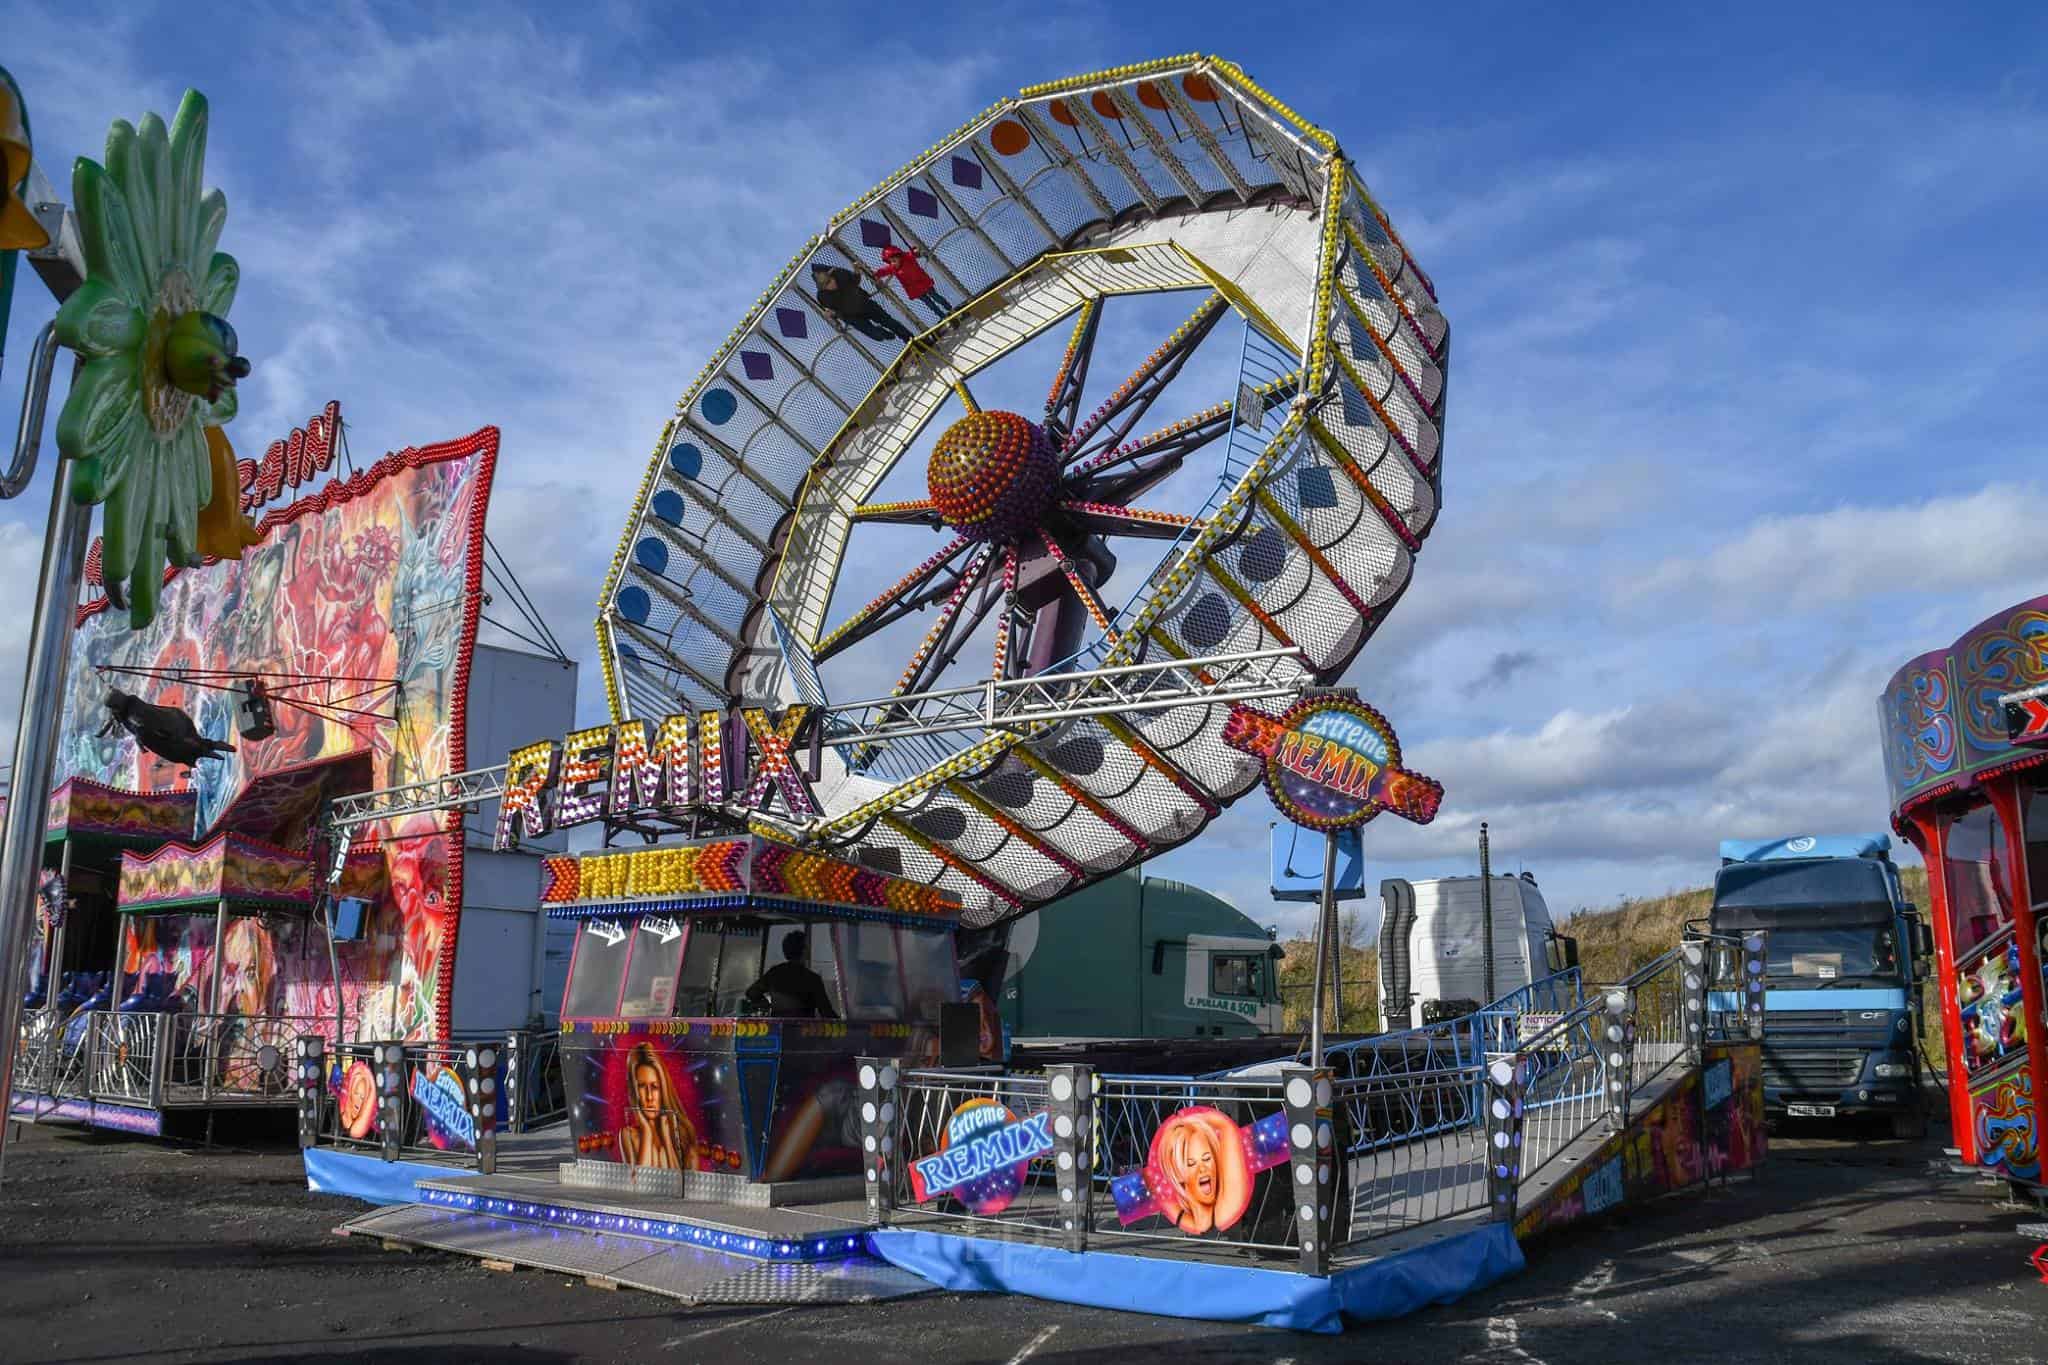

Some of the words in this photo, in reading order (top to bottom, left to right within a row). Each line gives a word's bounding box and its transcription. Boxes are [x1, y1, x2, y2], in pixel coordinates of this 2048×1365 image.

[1302, 713, 1388, 760] Extreme
[493, 704, 825, 851] REMIX
[1276, 730, 1379, 800] REMIX
[579, 852, 630, 901] PAY
[632, 845, 702, 897] HERE
[1238, 1002, 1257, 1018] SON
[1860, 1011, 1888, 1020] CF
[413, 1069, 477, 1147] REMIX
[949, 1106, 1007, 1144] Extreme
[916, 1111, 1054, 1195] REMIX
